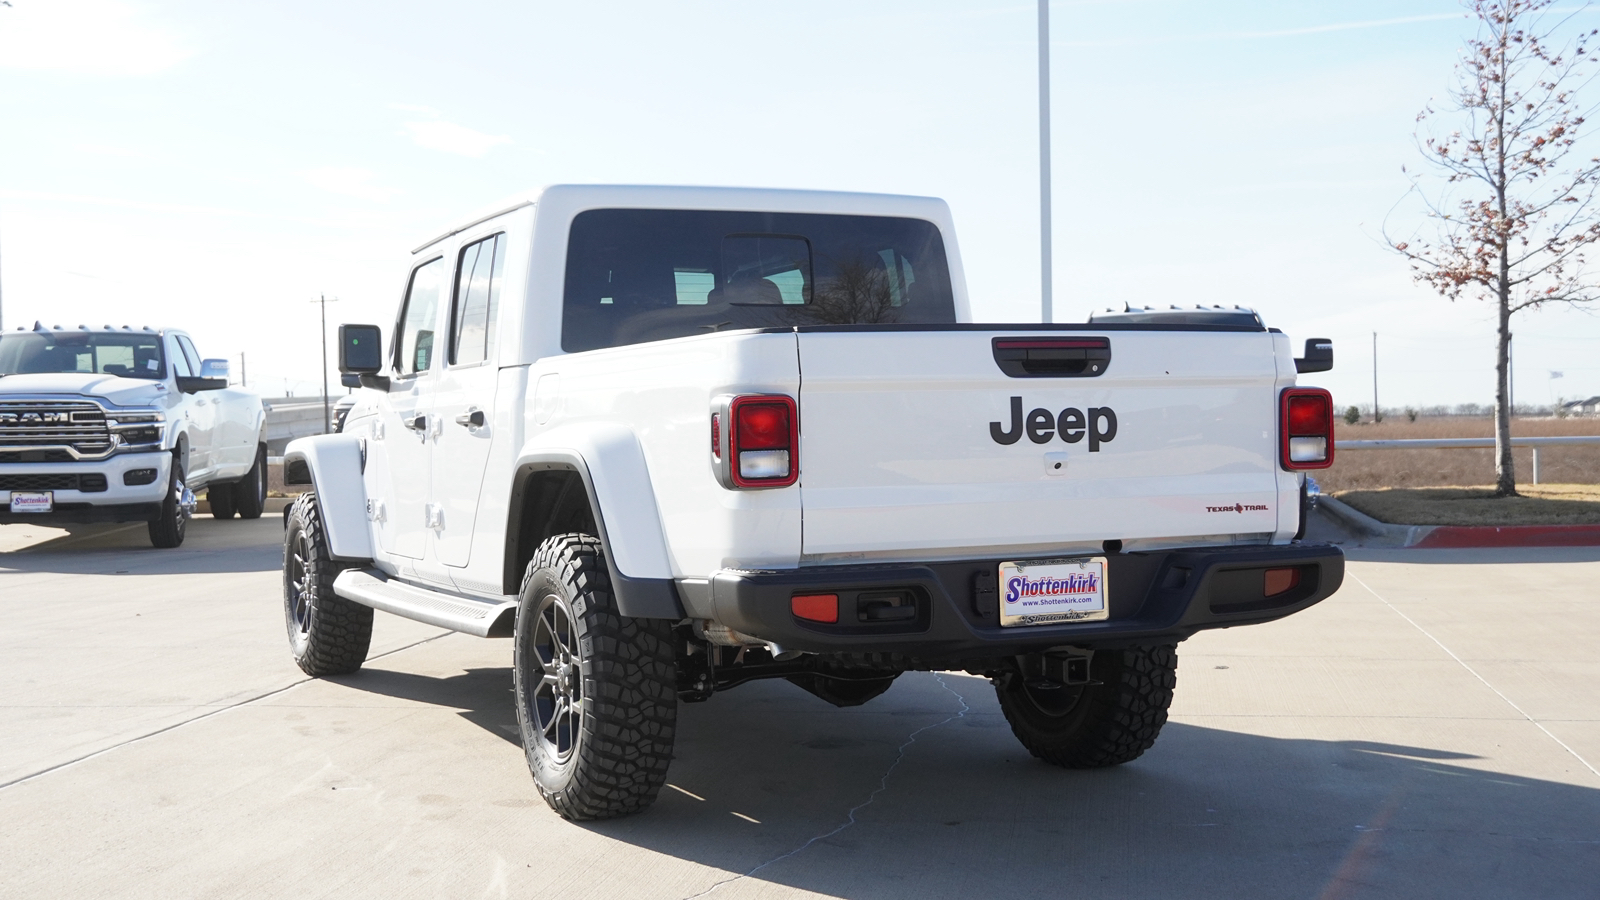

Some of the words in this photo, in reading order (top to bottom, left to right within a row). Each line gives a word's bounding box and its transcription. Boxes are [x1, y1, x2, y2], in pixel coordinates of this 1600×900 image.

[0, 412, 69, 422] RAM
[989, 396, 1118, 452] Jeep
[1006, 573, 1097, 603] Shottenkirk
[1022, 597, 1092, 607] www.Shottenkirk.com
